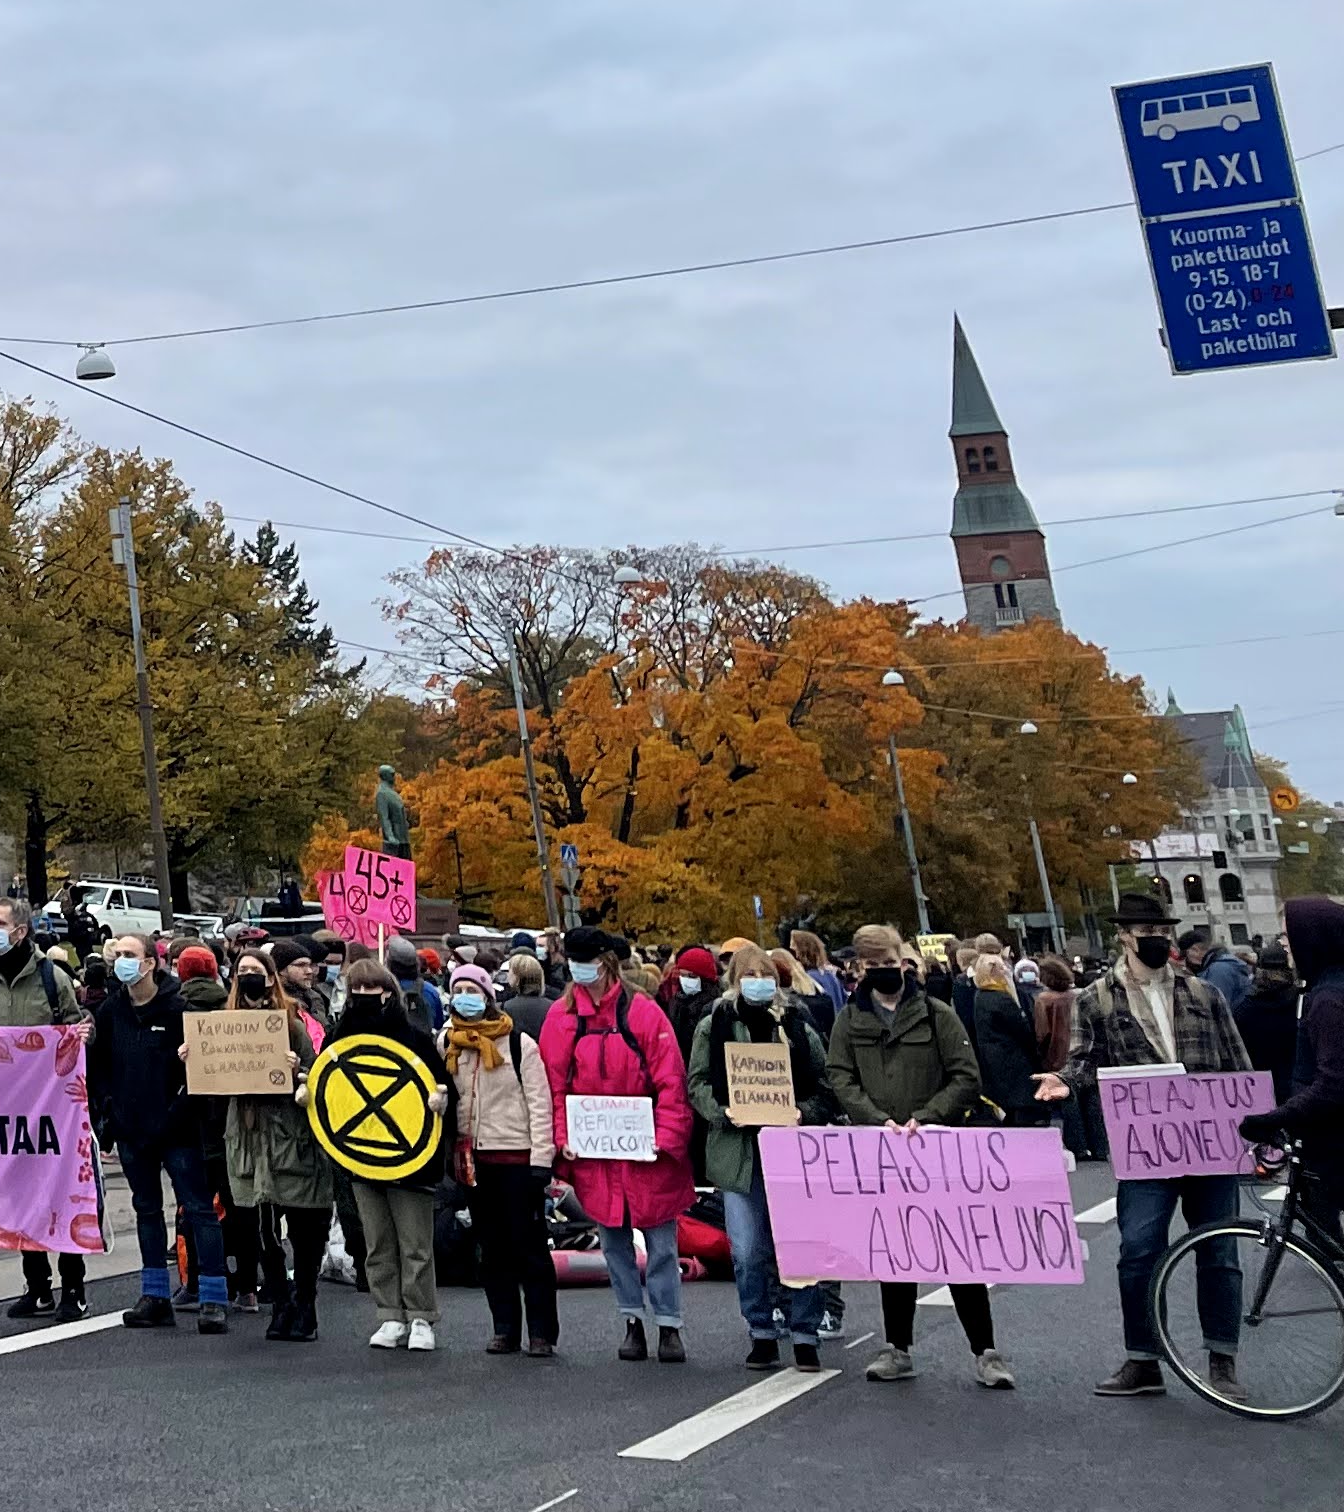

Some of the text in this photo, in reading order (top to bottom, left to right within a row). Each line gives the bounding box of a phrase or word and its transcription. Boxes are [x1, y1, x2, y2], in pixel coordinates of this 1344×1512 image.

[1161, 150, 1263, 194] TAXI
[1170, 217, 1281, 246] Kuorma- ja
[1170, 238, 1291, 272] pakettiautot
[1241, 261, 1279, 282] 18-7
[1197, 308, 1293, 335] Last- och
[1200, 332, 1298, 360] paketbilar
[355, 850, 404, 900] 45+
[580, 1097, 641, 1112] CLIMATE
[1110, 1076, 1256, 1121] PELASTUS
[797, 1129, 1011, 1199] PELASTUS
[1126, 1118, 1242, 1172] AJONEU
[868, 1201, 1077, 1276] AJONEUVOT
